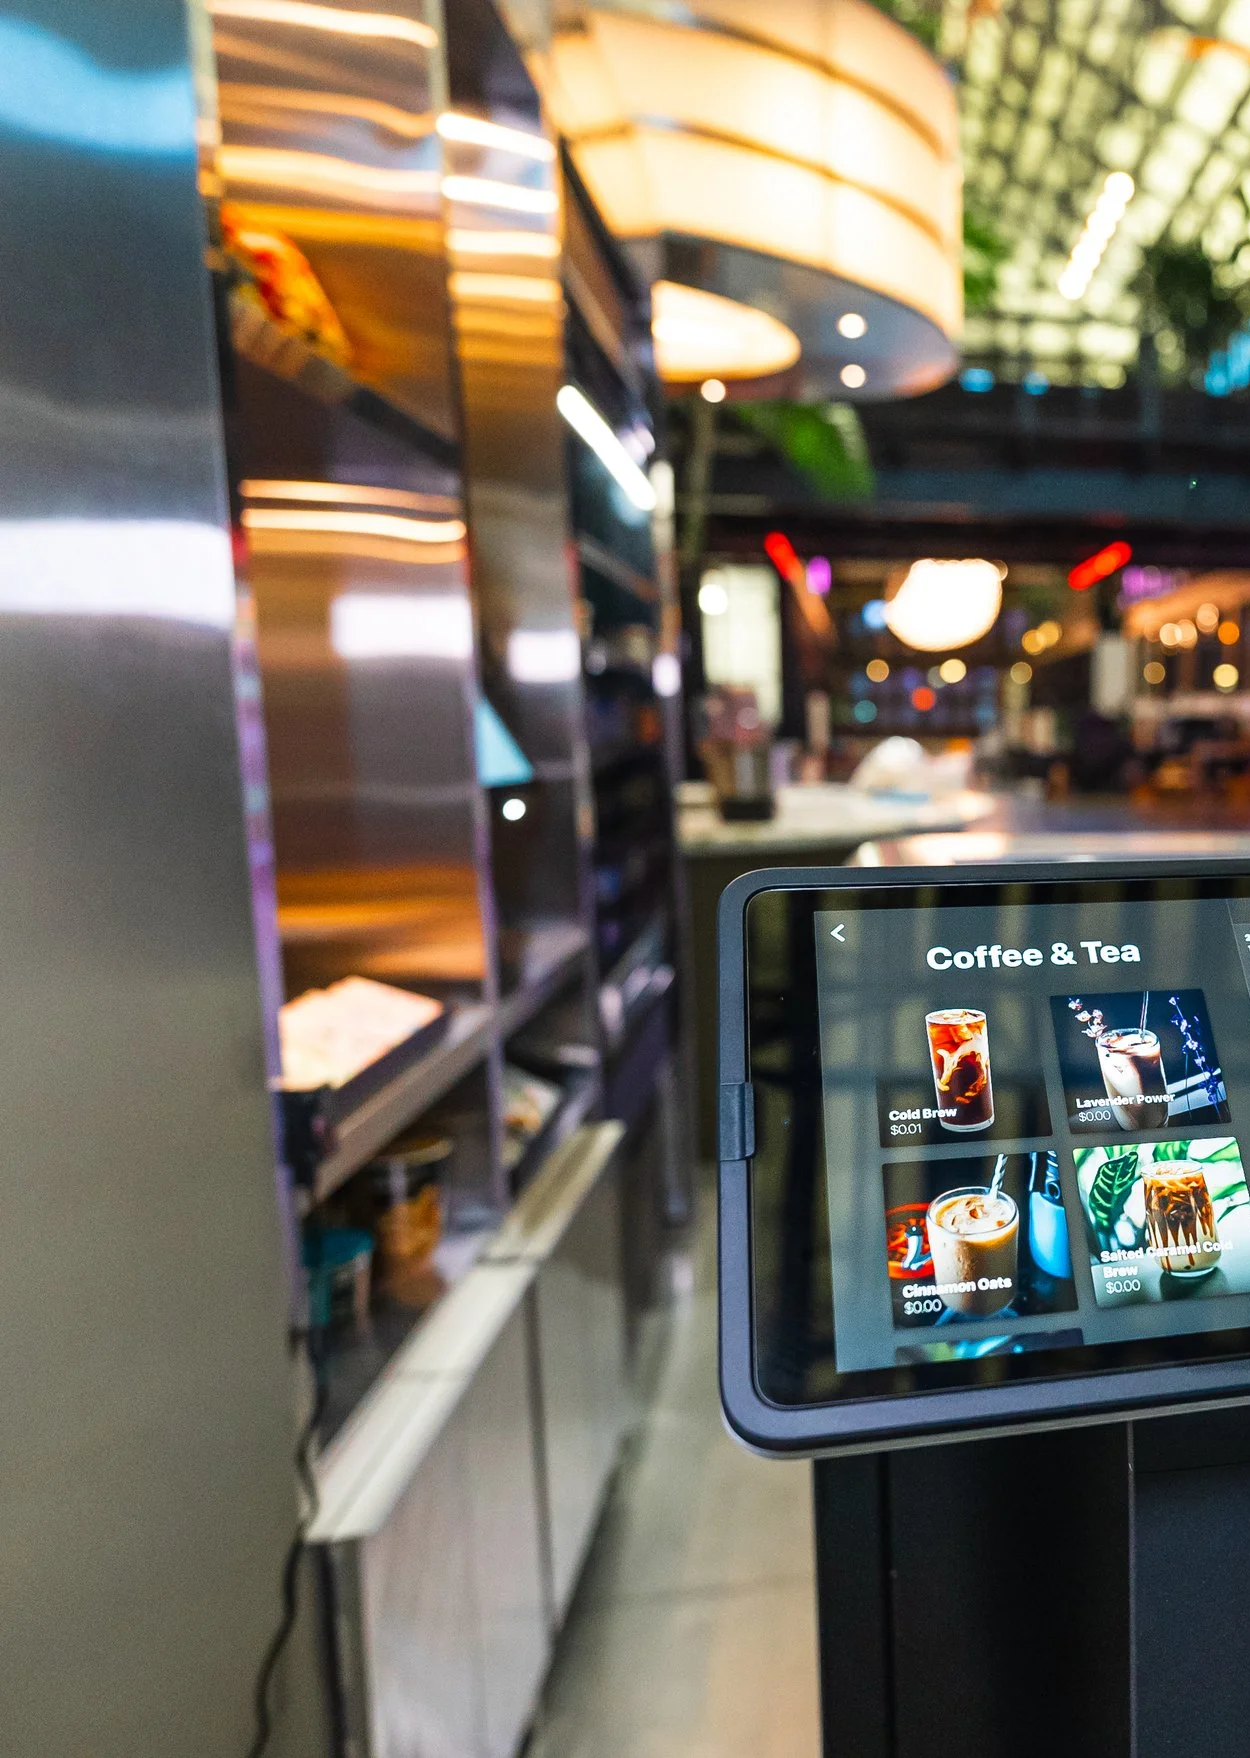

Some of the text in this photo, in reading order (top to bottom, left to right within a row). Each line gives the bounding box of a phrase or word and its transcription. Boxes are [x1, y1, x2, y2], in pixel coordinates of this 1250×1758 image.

[926, 940, 1141, 971] Coffee & Tea
[1076, 1092, 1176, 1109] Lavender Power
[888, 1106, 958, 1121] Cold Brew
[1078, 1110, 1111, 1123] $0.00
[890, 1123, 922, 1137] $0.01
[1100, 1240, 1233, 1263] Salted Caramel Cold
[1103, 1265, 1138, 1279] Brew
[902, 1276, 1013, 1298] Cinnamon Oats
[1105, 1279, 1141, 1295] $0.00
[903, 1299, 942, 1315] $0.00
